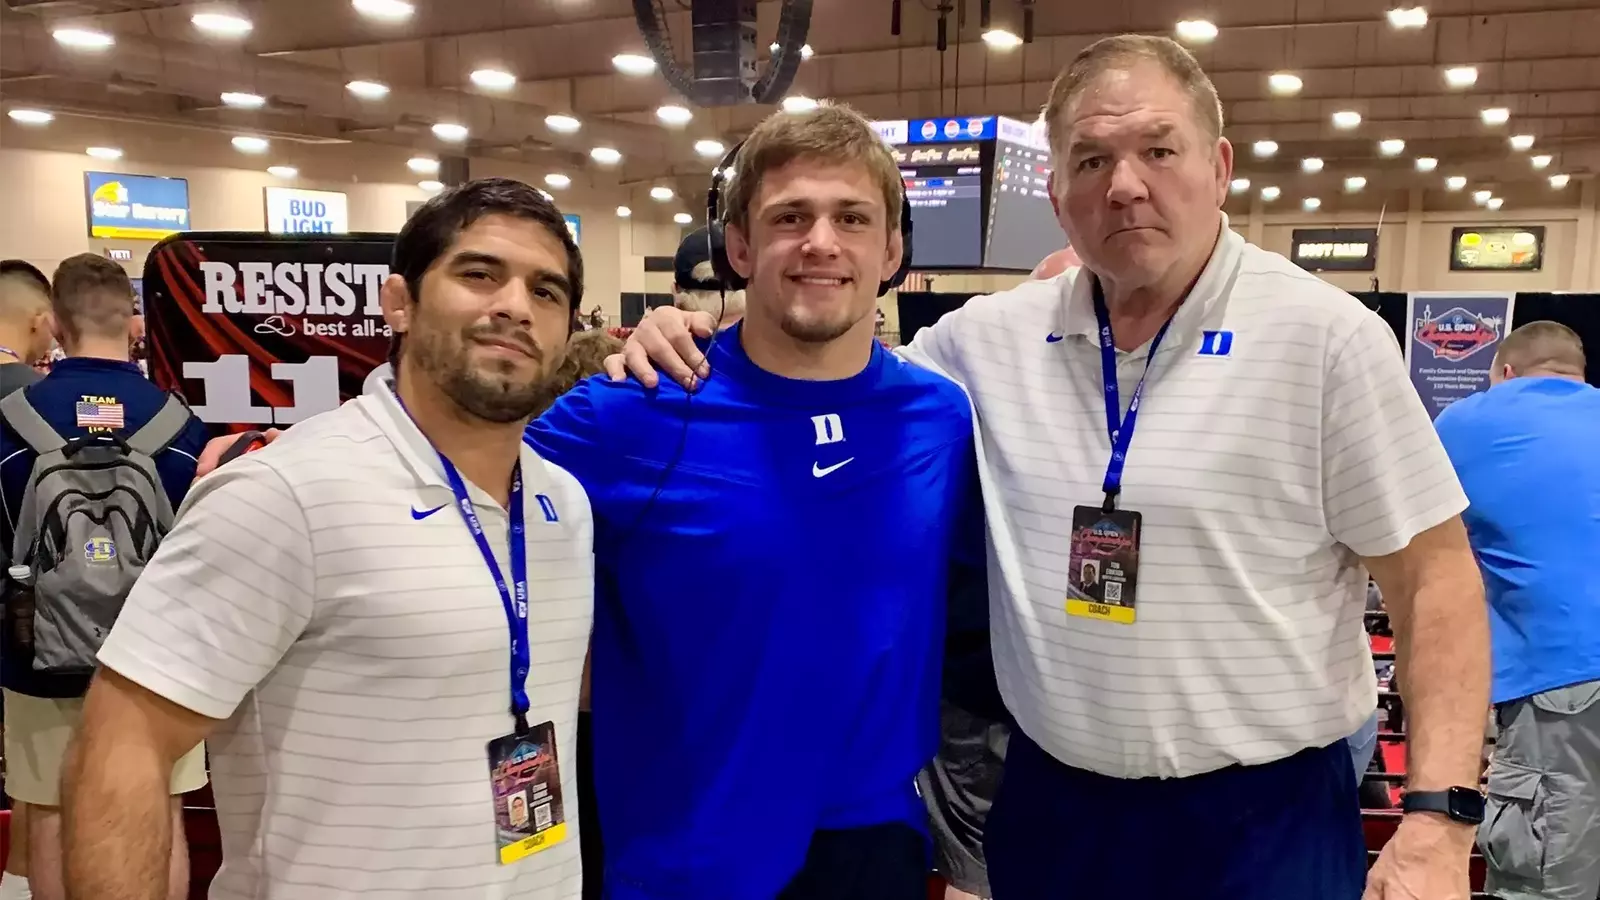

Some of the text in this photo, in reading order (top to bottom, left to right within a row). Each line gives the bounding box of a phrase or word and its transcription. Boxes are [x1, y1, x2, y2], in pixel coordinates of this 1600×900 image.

[289, 199, 327, 218] BUD
[283, 218, 333, 234] LIGHT
[303, 318, 347, 337] best
[1454, 323, 1476, 332] OPEN
[81, 395, 116, 405] TEAM
[469, 514, 482, 536] USA
[516, 581, 527, 601] USA
[1088, 603, 1111, 616] COACH
